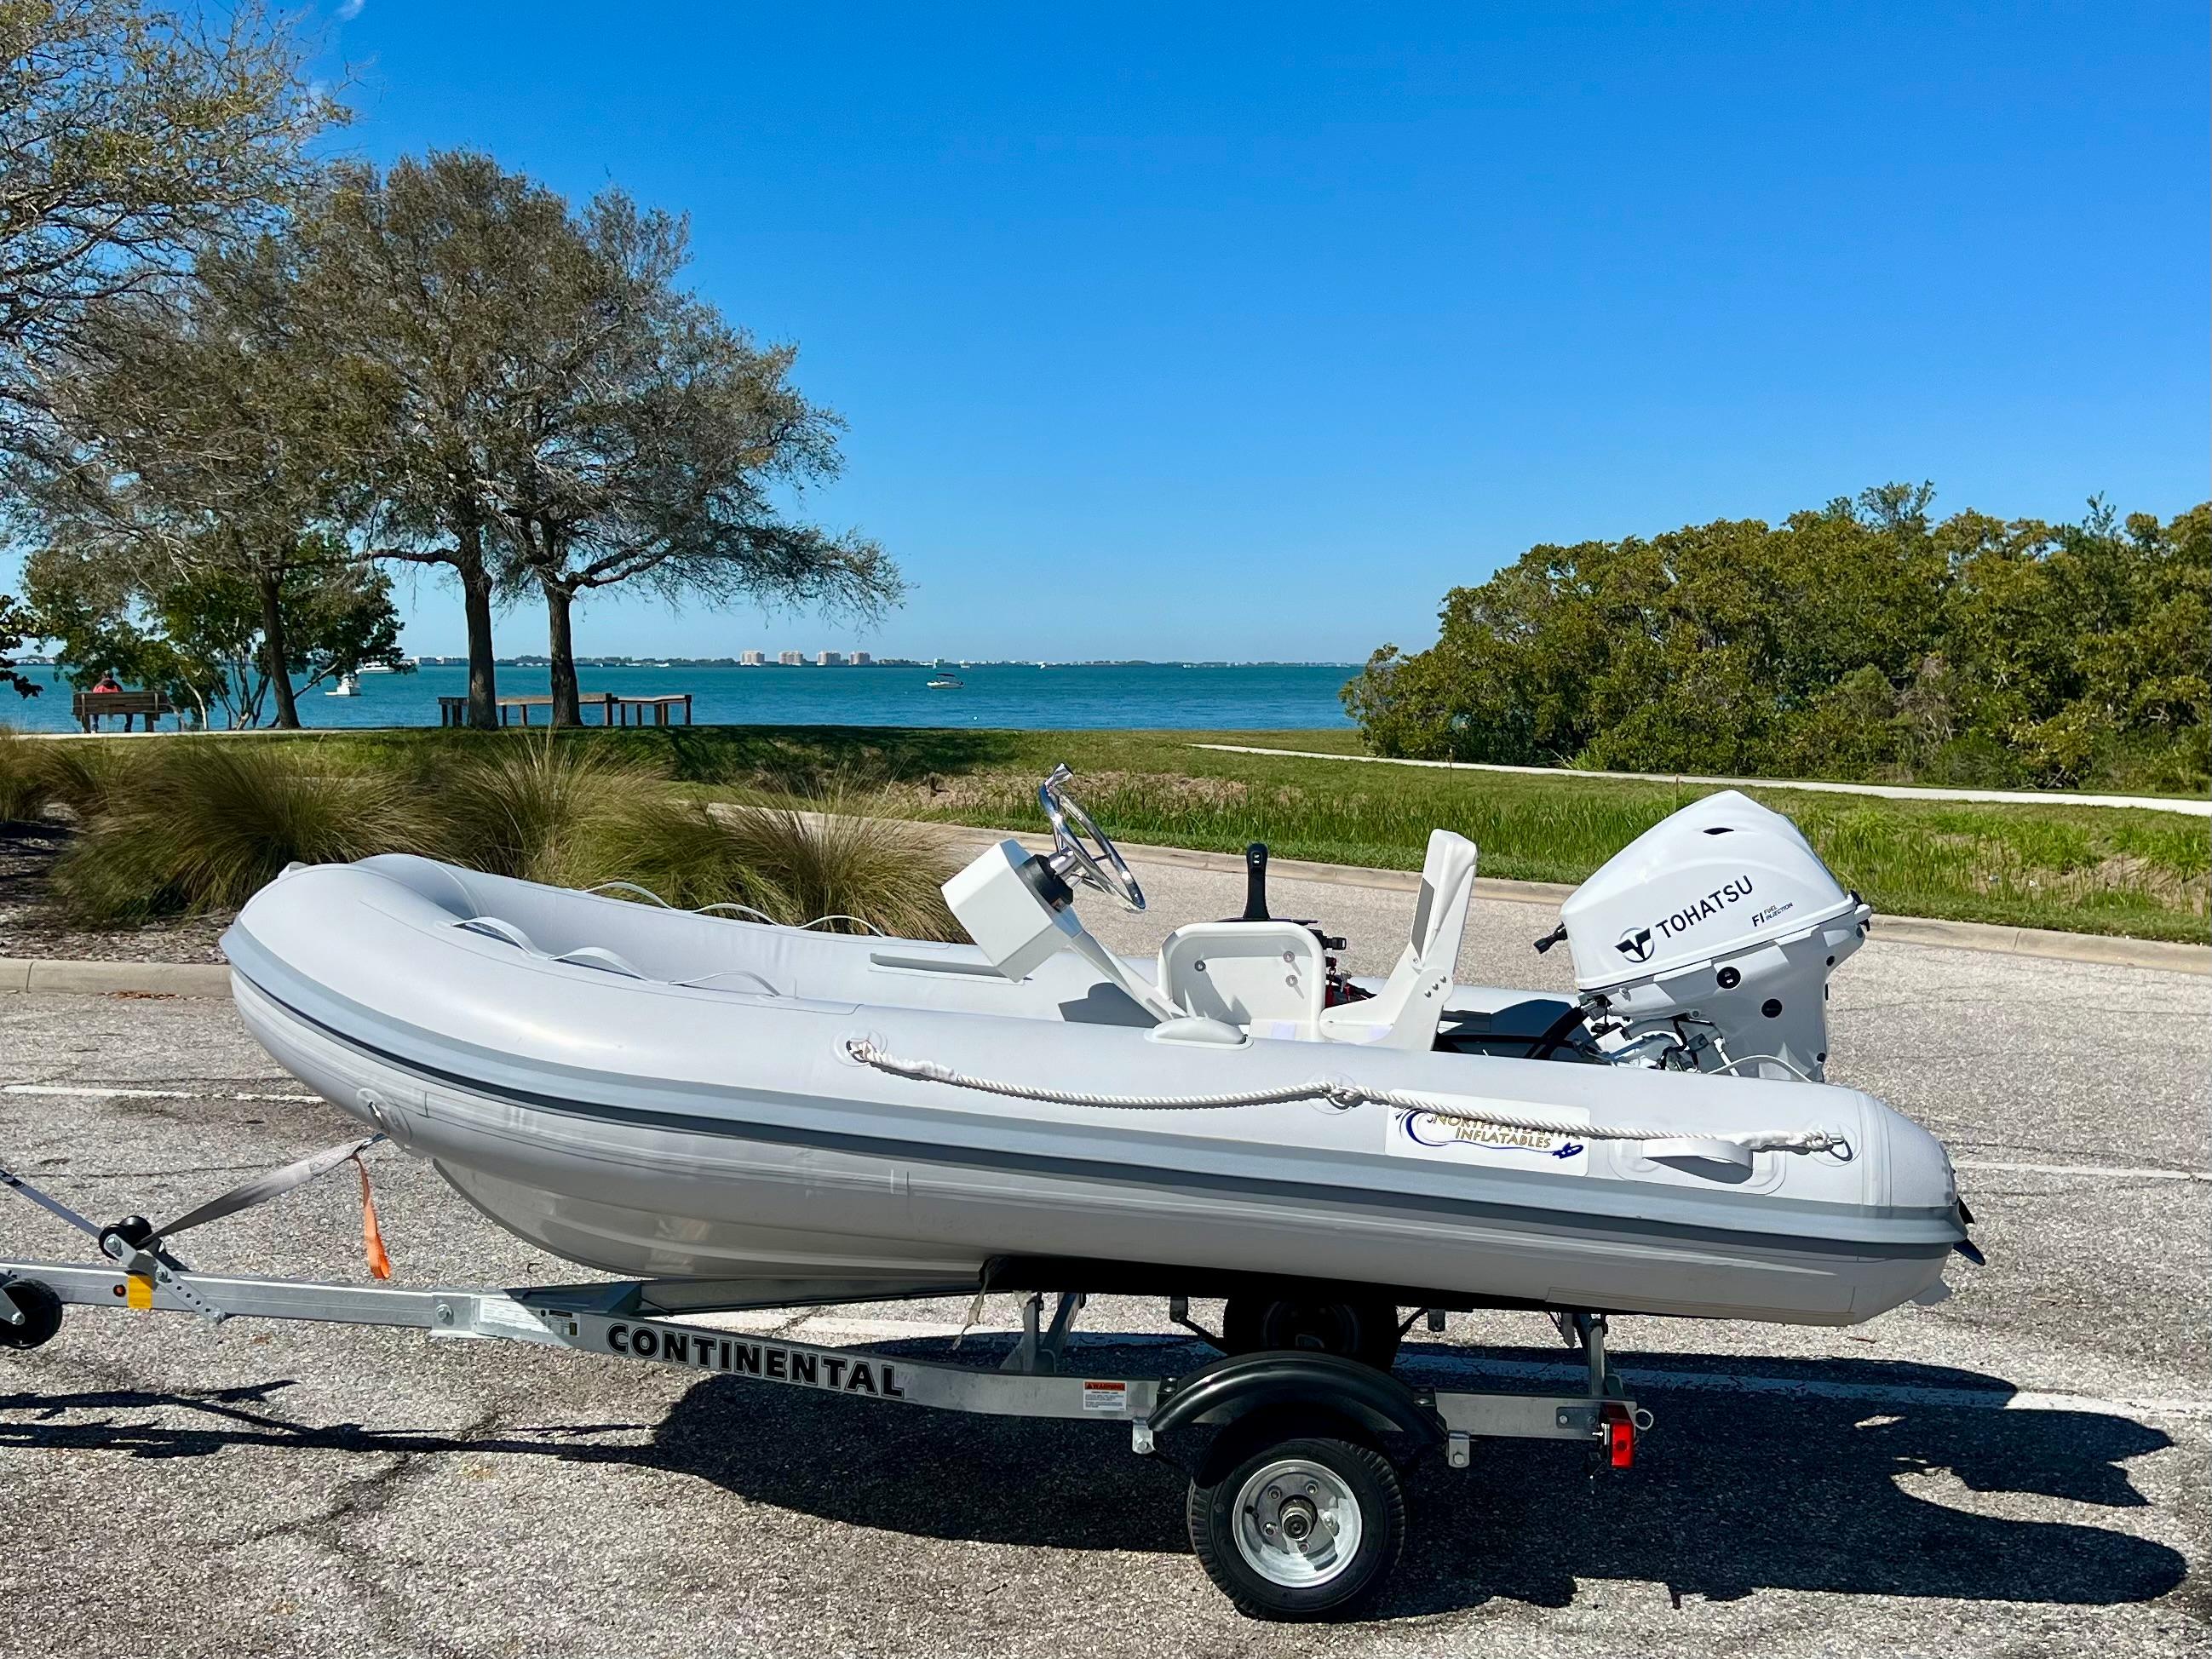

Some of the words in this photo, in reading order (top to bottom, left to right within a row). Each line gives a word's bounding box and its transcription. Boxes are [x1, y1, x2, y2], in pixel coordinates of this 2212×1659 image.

[1655, 875, 1753, 939] TOHATSU
[1751, 911, 1765, 927] FI
[1455, 1127, 1551, 1149] INFLATABLES
[606, 1323, 905, 1400] CONTINENTAL
